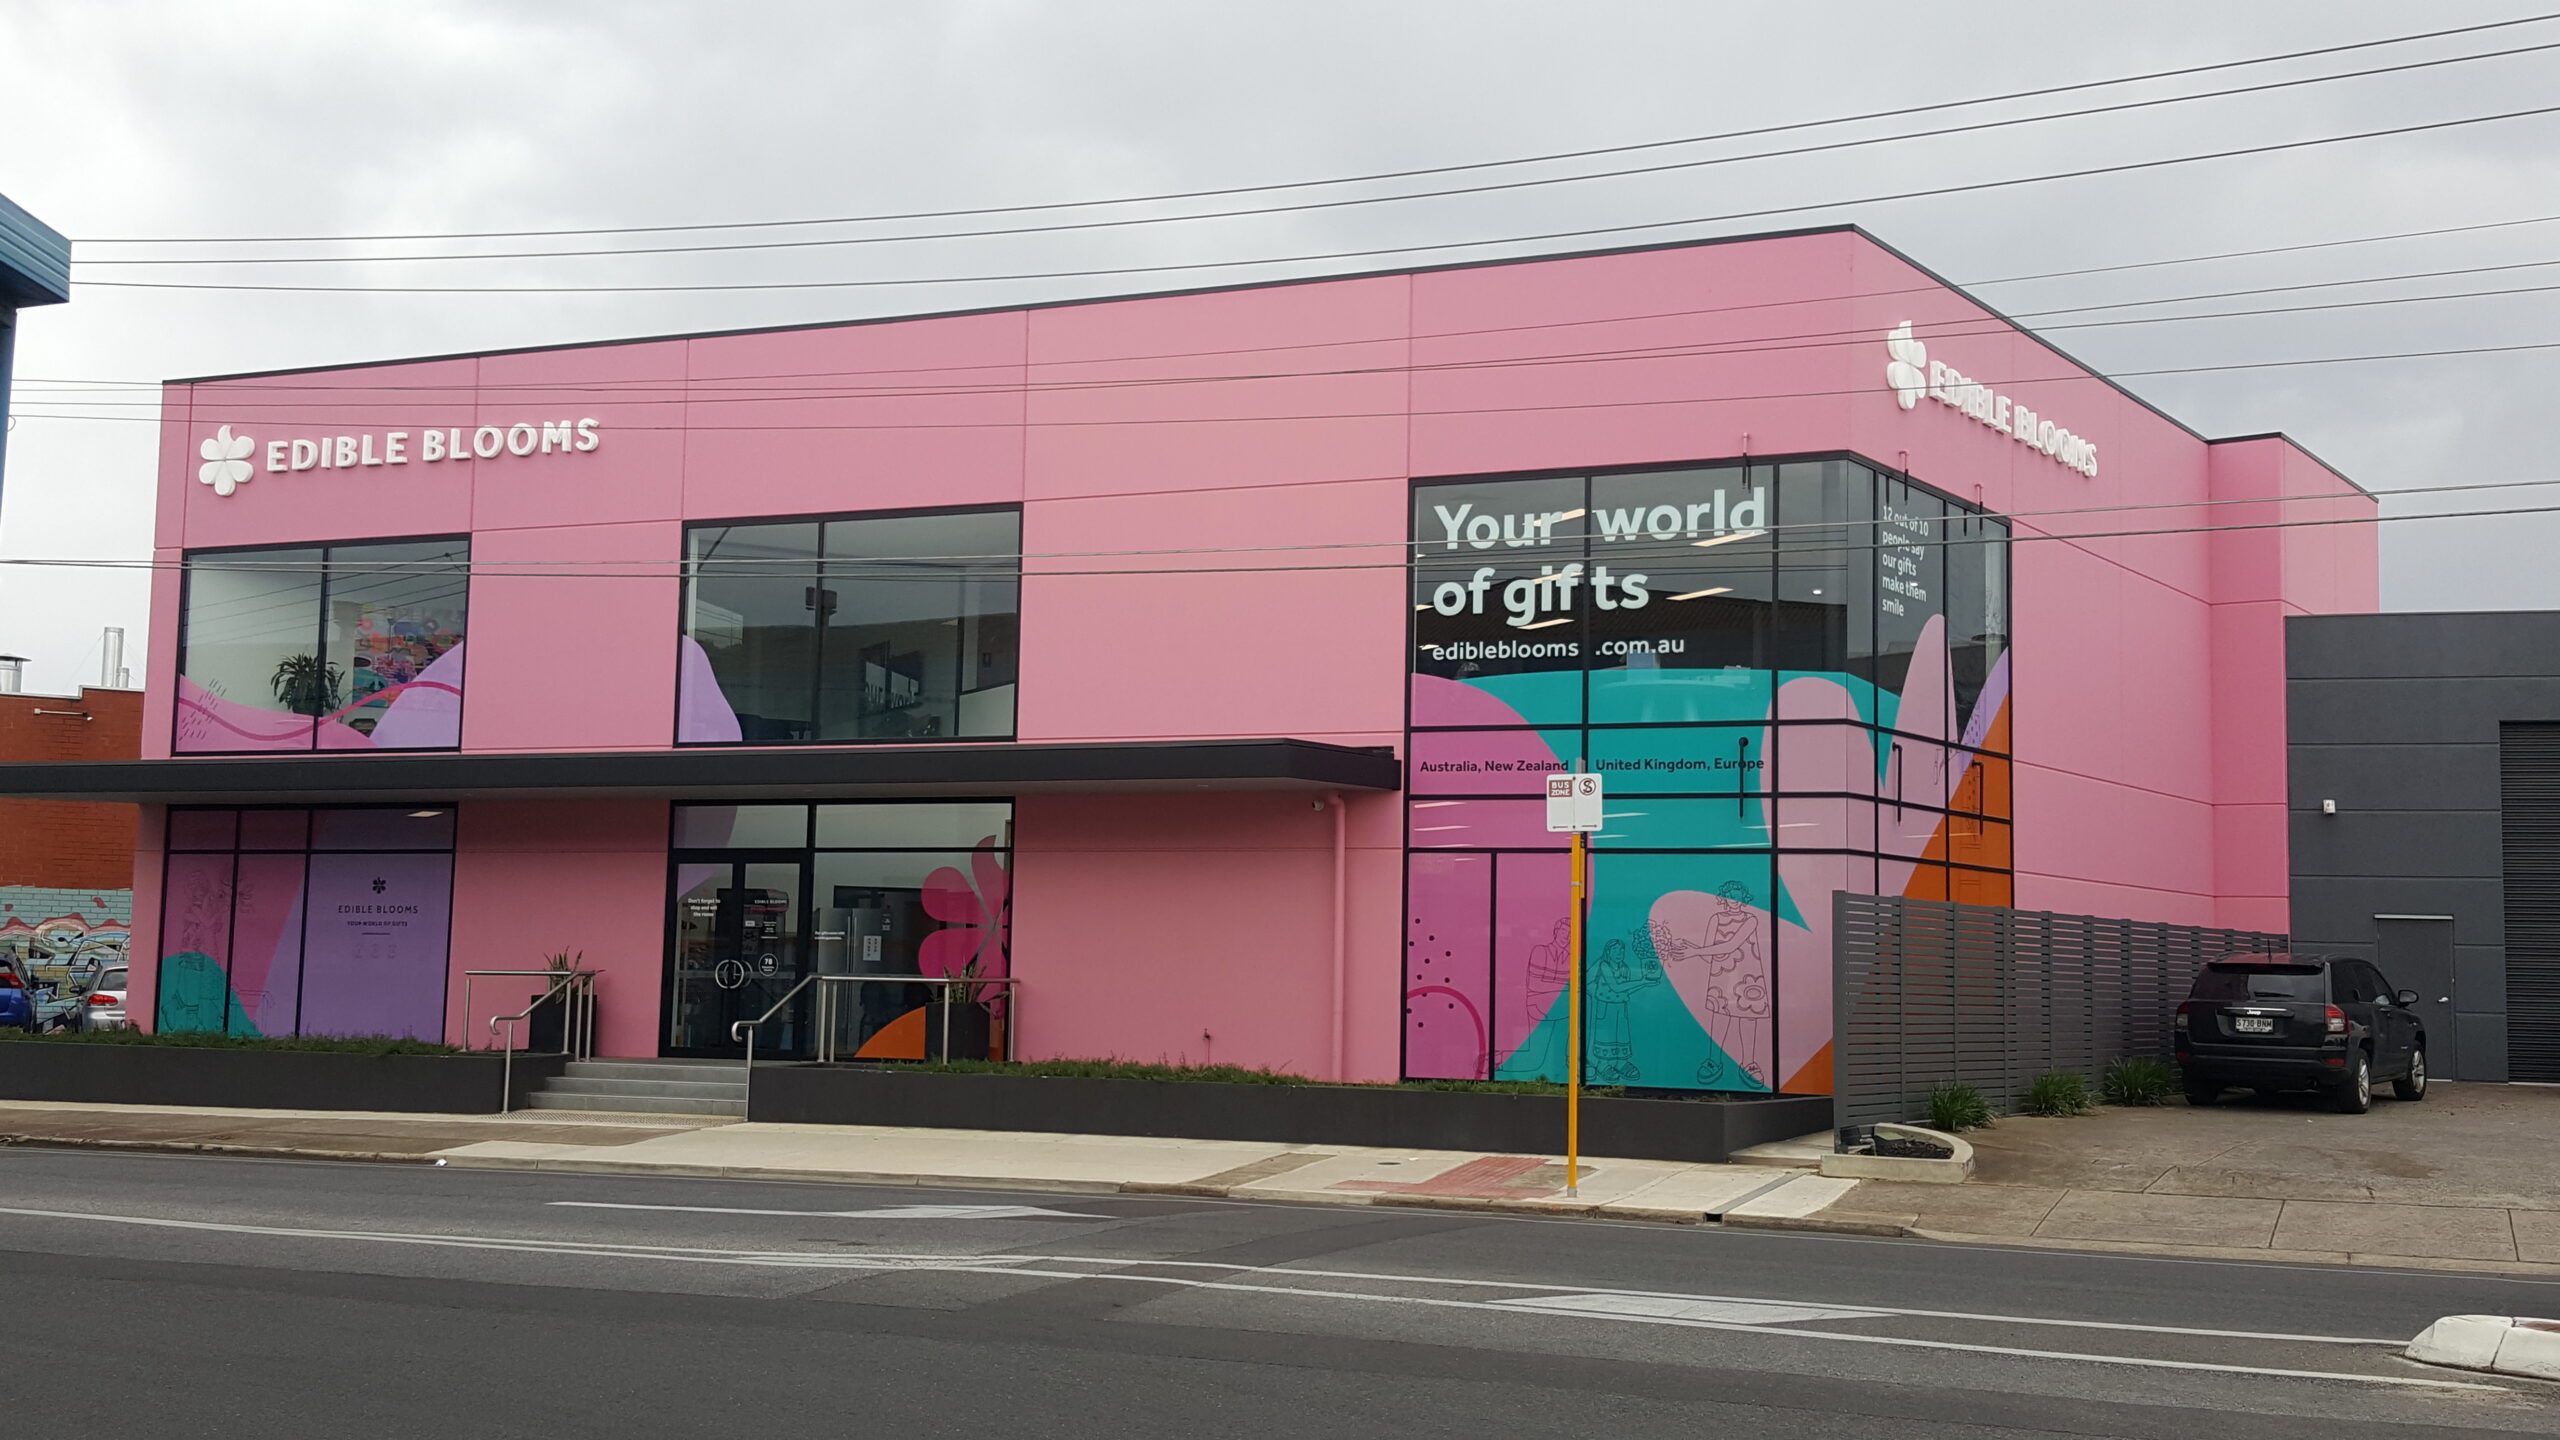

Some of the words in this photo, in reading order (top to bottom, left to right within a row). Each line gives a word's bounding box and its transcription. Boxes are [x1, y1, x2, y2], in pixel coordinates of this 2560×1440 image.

[1929, 360, 2012, 434] EDIBLE
[2013, 405, 2097, 477] BLOOMS
[267, 432, 408, 472] EDIBLE
[423, 418, 600, 462] BLOOMS
[1433, 503, 1563, 549] Your
[1592, 487, 1766, 542] world
[1883, 505, 1893, 521] 12
[1894, 513, 1908, 529] out
[1909, 516, 1919, 533] of
[1920, 521, 1929, 536] 10
[1882, 531, 1910, 552] people
[1911, 541, 1925, 560] say
[1882, 554, 1896, 569] our
[1897, 557, 1917, 577] gifts
[1433, 567, 1496, 617] of
[1503, 563, 1649, 627] gifts
[1882, 576, 1904, 595] make
[1905, 581, 1927, 603] them
[1882, 598, 1905, 617] smile
[1419, 760, 1482, 773] Australia,
[1484, 760, 1514, 772] New
[1516, 760, 1569, 772] Zealand
[1595, 758, 1642, 771] United
[1644, 757, 1711, 773] Kingdom,
[1713, 757, 1765, 772] Europe
[1552, 781, 1570, 789] BUS
[338, 905, 373, 914] EDIBLE
[376, 905, 419, 914] BLOOMS
